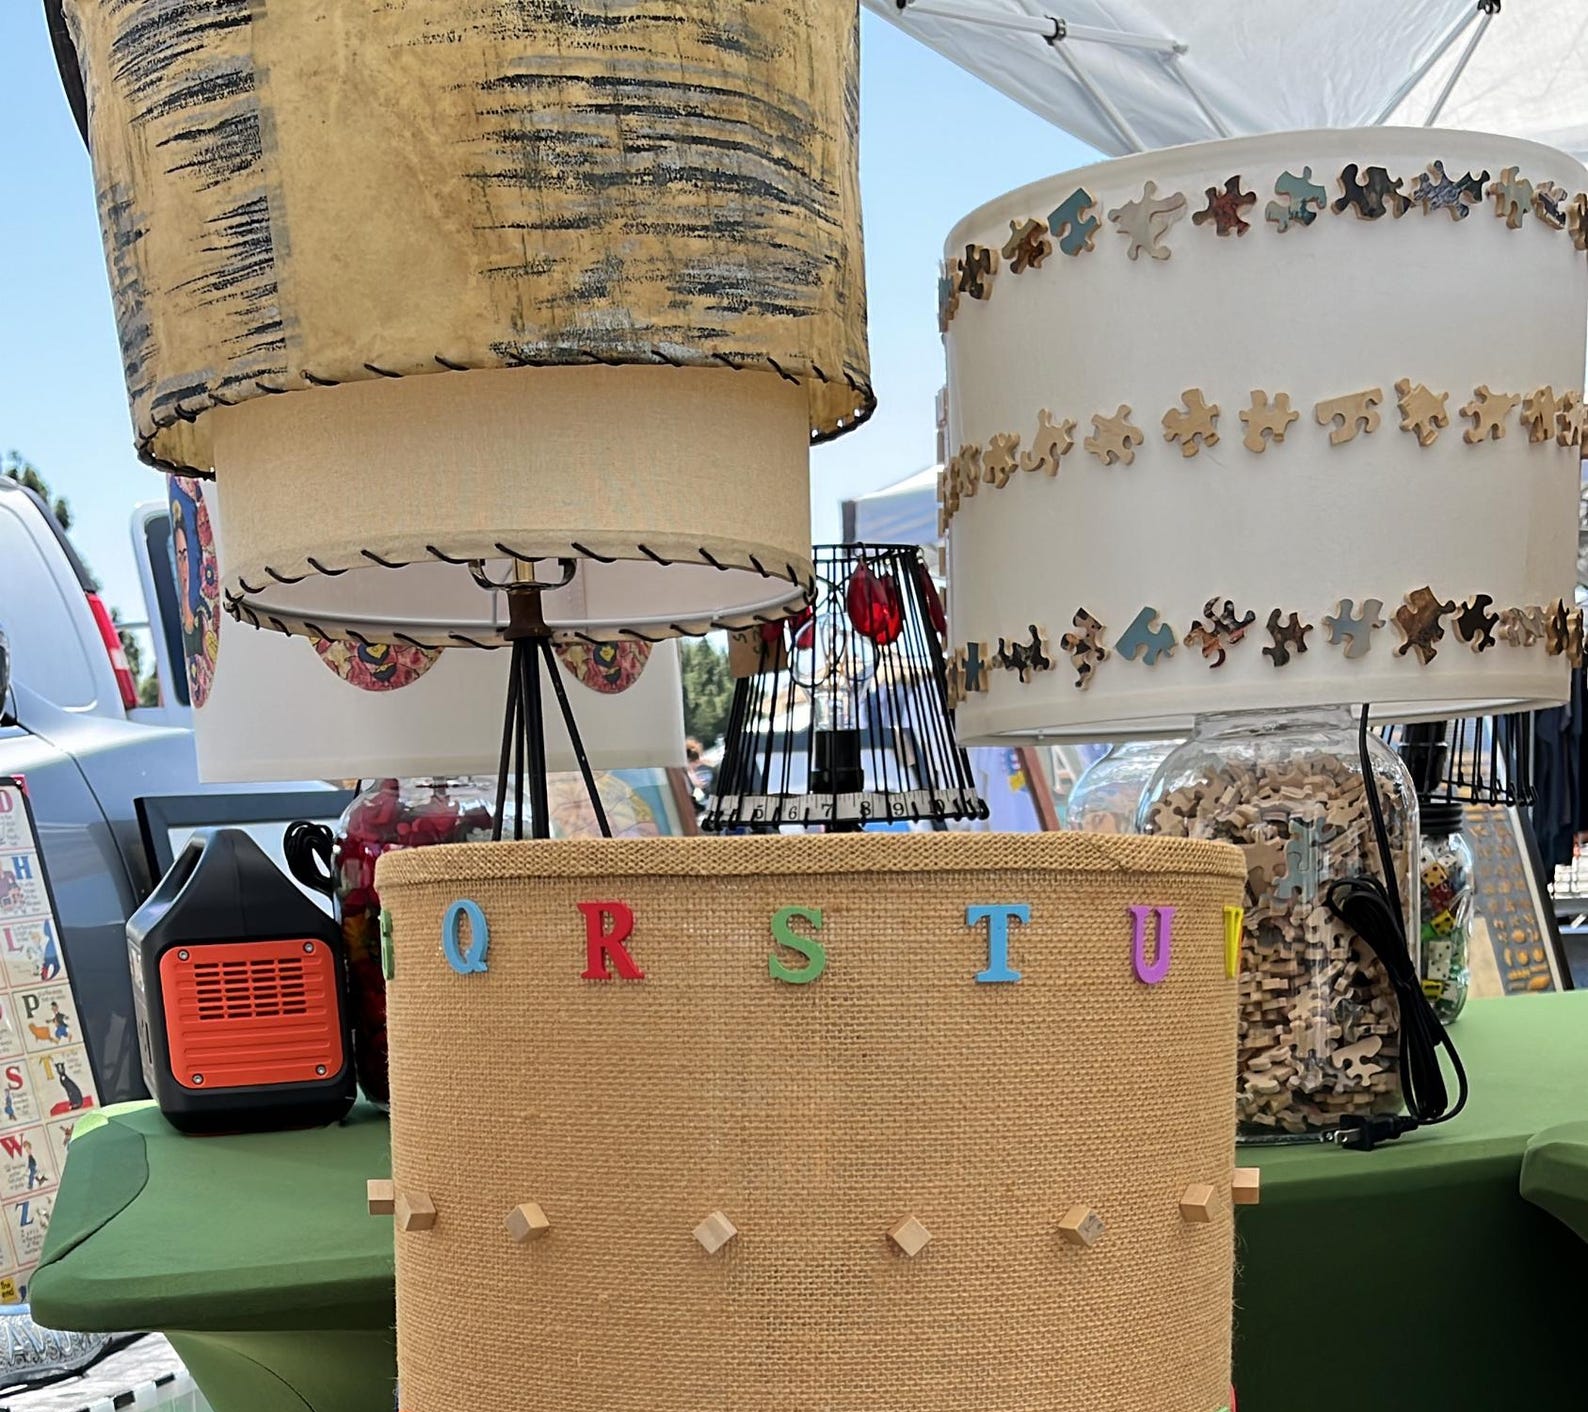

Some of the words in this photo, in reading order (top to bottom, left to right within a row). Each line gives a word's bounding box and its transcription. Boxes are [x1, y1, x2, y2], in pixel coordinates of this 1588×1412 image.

[788, 804, 798, 820] 6
[822, 802, 833, 818] 7
[892, 801, 905, 817] 9
[441, 899, 489, 975] Q
[577, 902, 645, 980] R
[769, 906, 827, 984] S
[966, 904, 1031, 984] T
[1129, 905, 1175, 984] U
[21, 993, 41, 1019] P
[5, 1065, 24, 1091] S
[39, 1055, 55, 1081] T
[0, 1133, 25, 1160] W
[15, 1200, 34, 1228] Z
